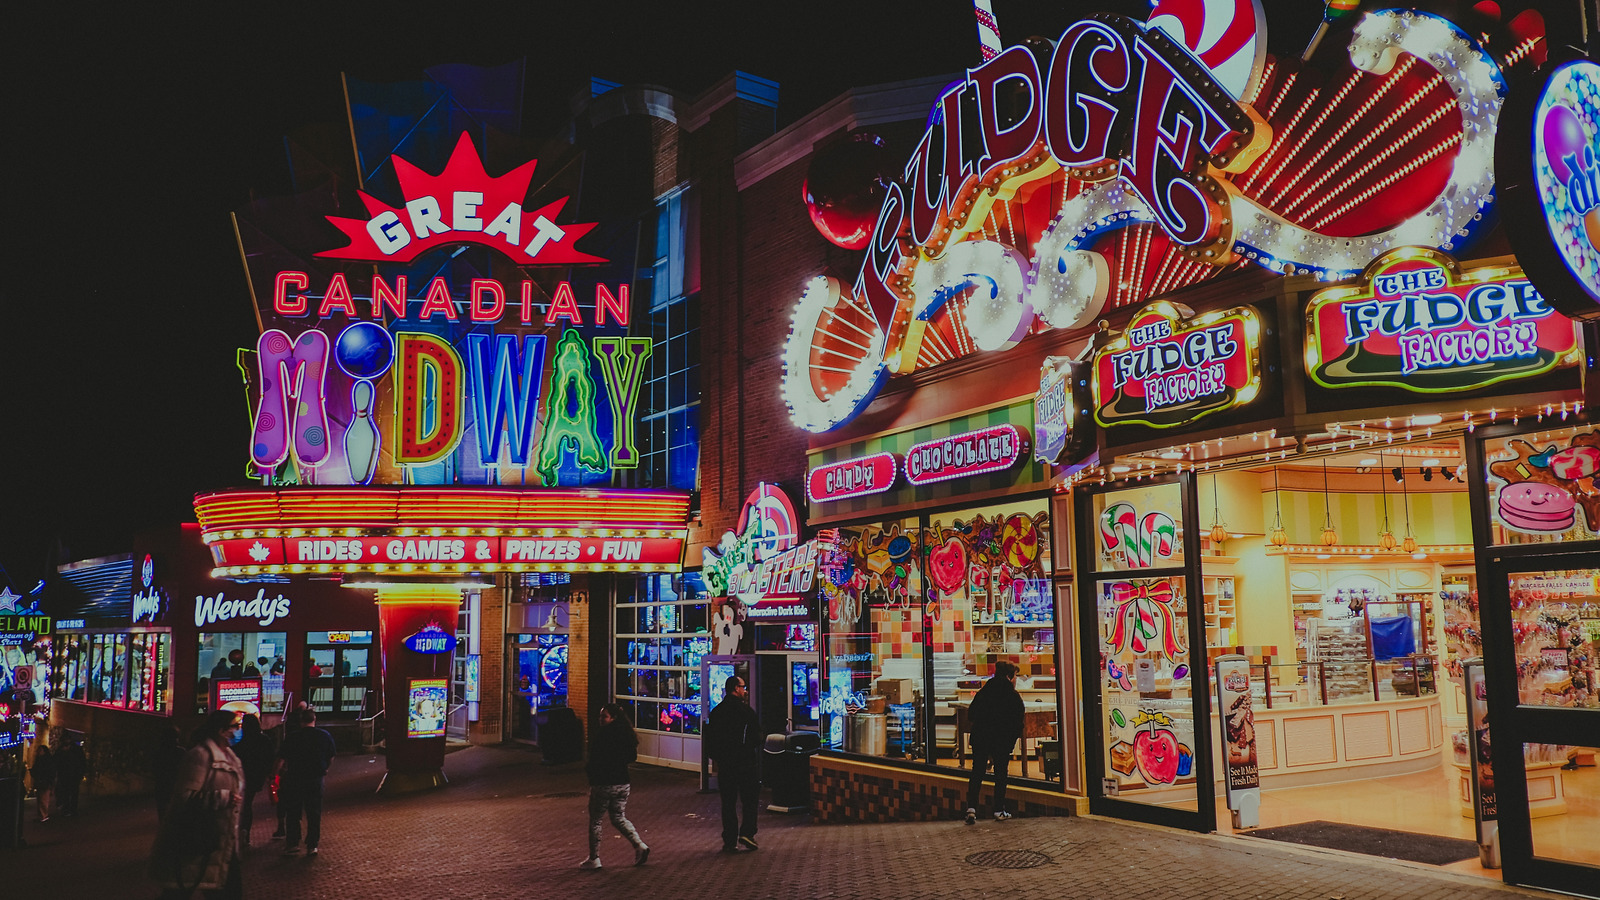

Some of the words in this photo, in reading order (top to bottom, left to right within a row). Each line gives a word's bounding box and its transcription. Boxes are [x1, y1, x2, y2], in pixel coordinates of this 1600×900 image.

[852, 19, 1231, 358] FUDGE
[1563, 144, 1600, 216] di
[366, 191, 566, 257] GREAT
[274, 270, 630, 326] CANADIAN
[1375, 266, 1445, 297] THE
[1342, 280, 1555, 345] FUDGE
[1129, 319, 1171, 347] THE
[1400, 322, 1538, 376] FACTORY
[1110, 324, 1237, 388] FUDGE
[1144, 363, 1226, 414] FACTORY
[911, 432, 1013, 476] CHOCOLATE
[825, 461, 875, 495] CANDY
[298, 541, 363, 560] RIDES
[386, 540, 465, 560] GAMES
[475, 541, 492, 560] &
[506, 540, 581, 560] PRIZES
[602, 541, 642, 560] FUN
[702, 519, 761, 597] GHOST
[727, 540, 818, 596] BLASTERS
[133, 586, 160, 623] Wendy's
[195, 588, 291, 627] Wendy's
[748, 606, 778, 617] Interactive
[778, 606, 793, 616] Dark
[794, 605, 808, 616] Ride
[0, 631, 24, 639] useum
[24, 631, 34, 641] of
[328, 633, 350, 642] OPEN
[1230, 767, 1240, 776] See
[1240, 766, 1245, 775] It
[1245, 765, 1258, 775] Made
[1231, 775, 1247, 786] Fresh
[1247, 774, 1258, 785] Daily
[1482, 793, 1493, 804] See
